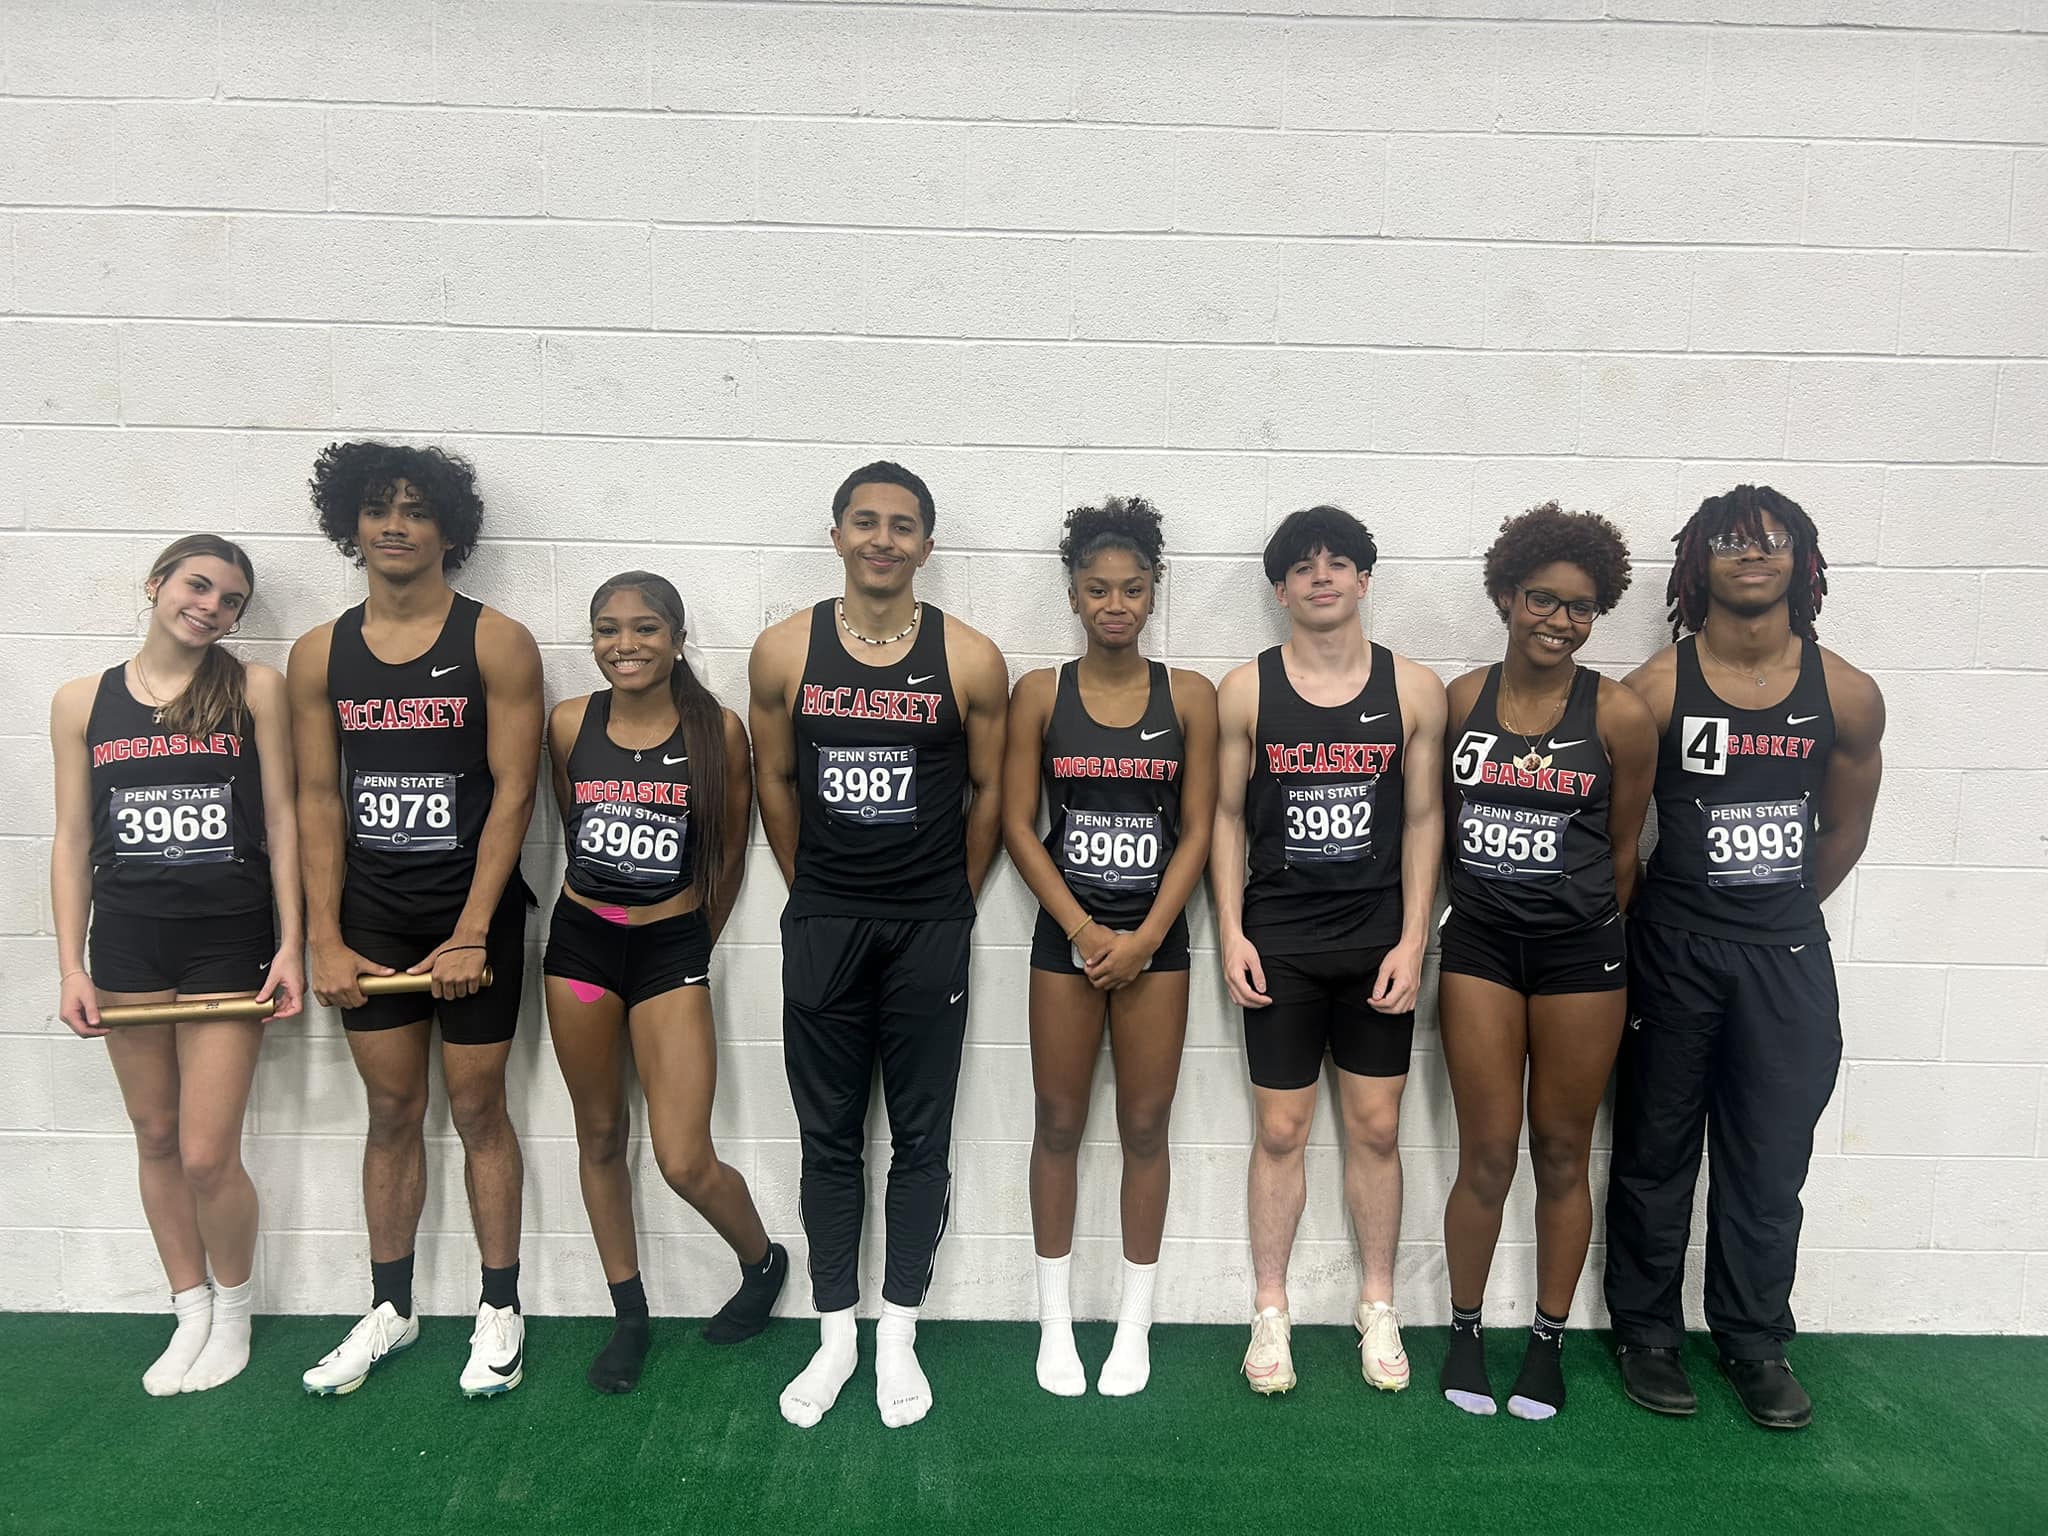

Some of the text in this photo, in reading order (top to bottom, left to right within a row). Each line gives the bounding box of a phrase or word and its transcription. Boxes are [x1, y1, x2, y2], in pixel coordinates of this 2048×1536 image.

[829, 750, 909, 762] PENN STATE
[1455, 735, 1488, 780] 5
[1687, 721, 1720, 770] 4
[1727, 734, 1815, 759] CASKEY
[1053, 756, 1178, 781] MCCASKEY
[124, 787, 221, 803] PENN STATE
[363, 776, 445, 788] PENN STATE
[575, 780, 689, 806] MCCASKE
[823, 766, 914, 803] 3987
[1289, 785, 1367, 801] PENN STATE
[358, 791, 451, 829] 3978
[595, 803, 677, 824] PENN STATE
[1075, 815, 1154, 829] PENN STATE
[1286, 801, 1372, 841] 3982
[1473, 804, 1558, 827] PENN STATE
[1711, 804, 1799, 821] PENN STATE
[116, 803, 227, 844] 3968
[581, 818, 680, 863] 3966
[1068, 830, 1158, 868] 3960
[1462, 818, 1557, 863] 3958
[1706, 821, 1803, 864] 3993
